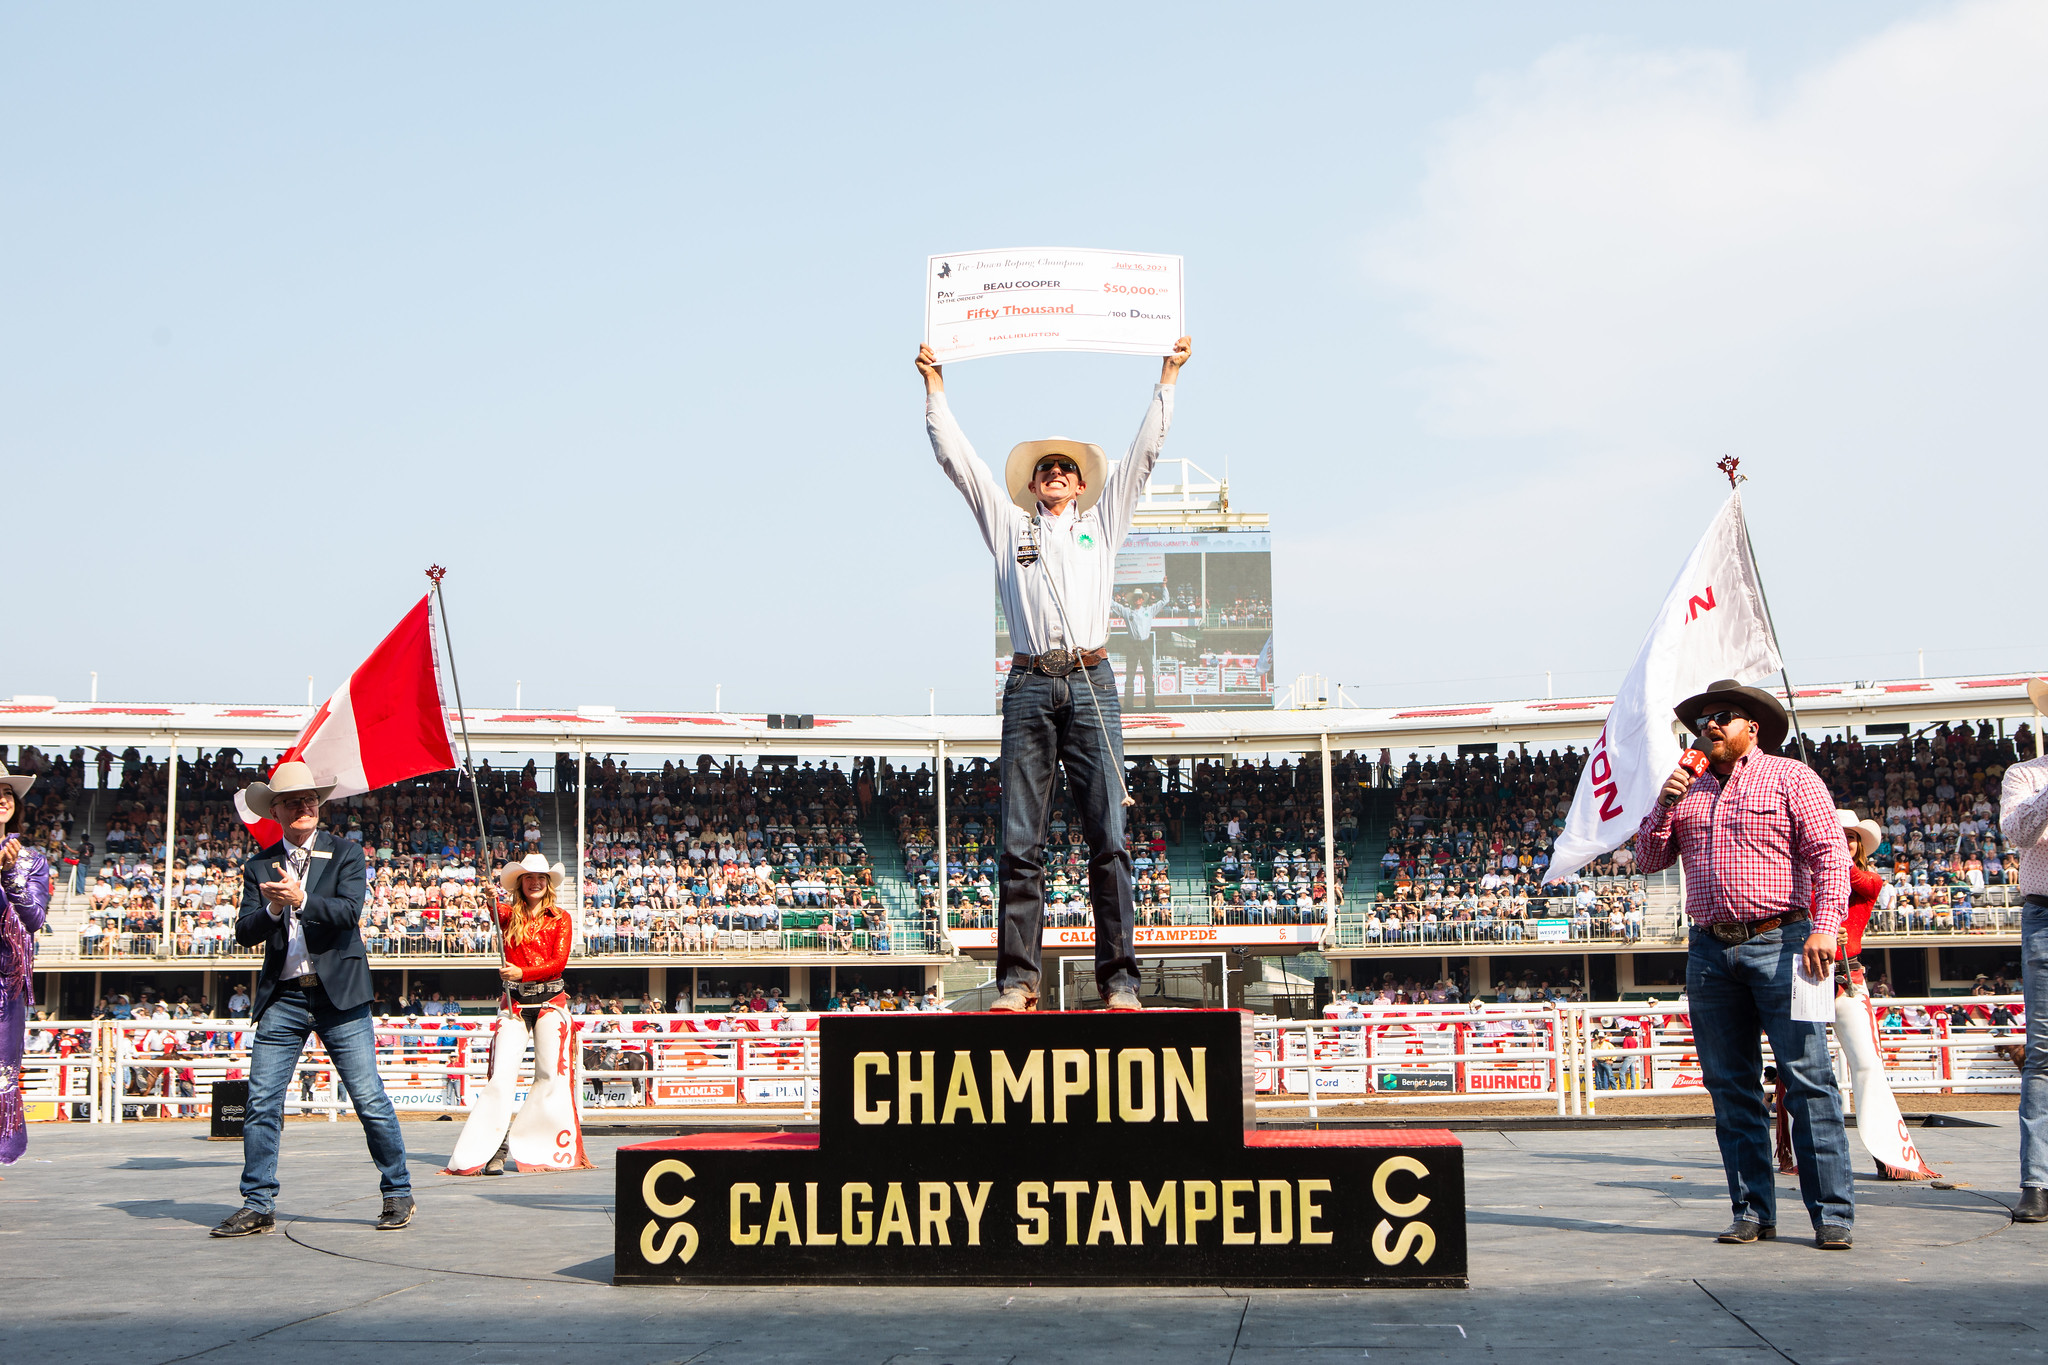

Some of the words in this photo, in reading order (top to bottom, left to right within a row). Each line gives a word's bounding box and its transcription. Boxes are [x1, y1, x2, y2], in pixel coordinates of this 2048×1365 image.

[1004, 259, 1035, 269] Roping
[1037, 258, 1084, 268] Champion
[1115, 262, 1132, 270] July
[983, 282, 1013, 291] BEAU
[1015, 280, 1061, 289] COOPER
[966, 307, 1000, 320] Fifty
[1002, 304, 1074, 315] Thousand
[988, 331, 1060, 341] HALLIBURTON
[1135, 929, 1217, 941] STAMPEDE
[852, 1046, 1209, 1125] CHAMPION
[1315, 1078, 1339, 1087] Cord
[1401, 1078, 1428, 1086] Bennett
[1429, 1078, 1448, 1088] Jones
[1470, 1074, 1542, 1090] BURNCO
[669, 1086, 724, 1096] LAMMLE'S
[775, 1085, 819, 1097] PLAIS
[729, 1180, 993, 1246] CALGARY
[1016, 1178, 1334, 1246] STAMPEDE
